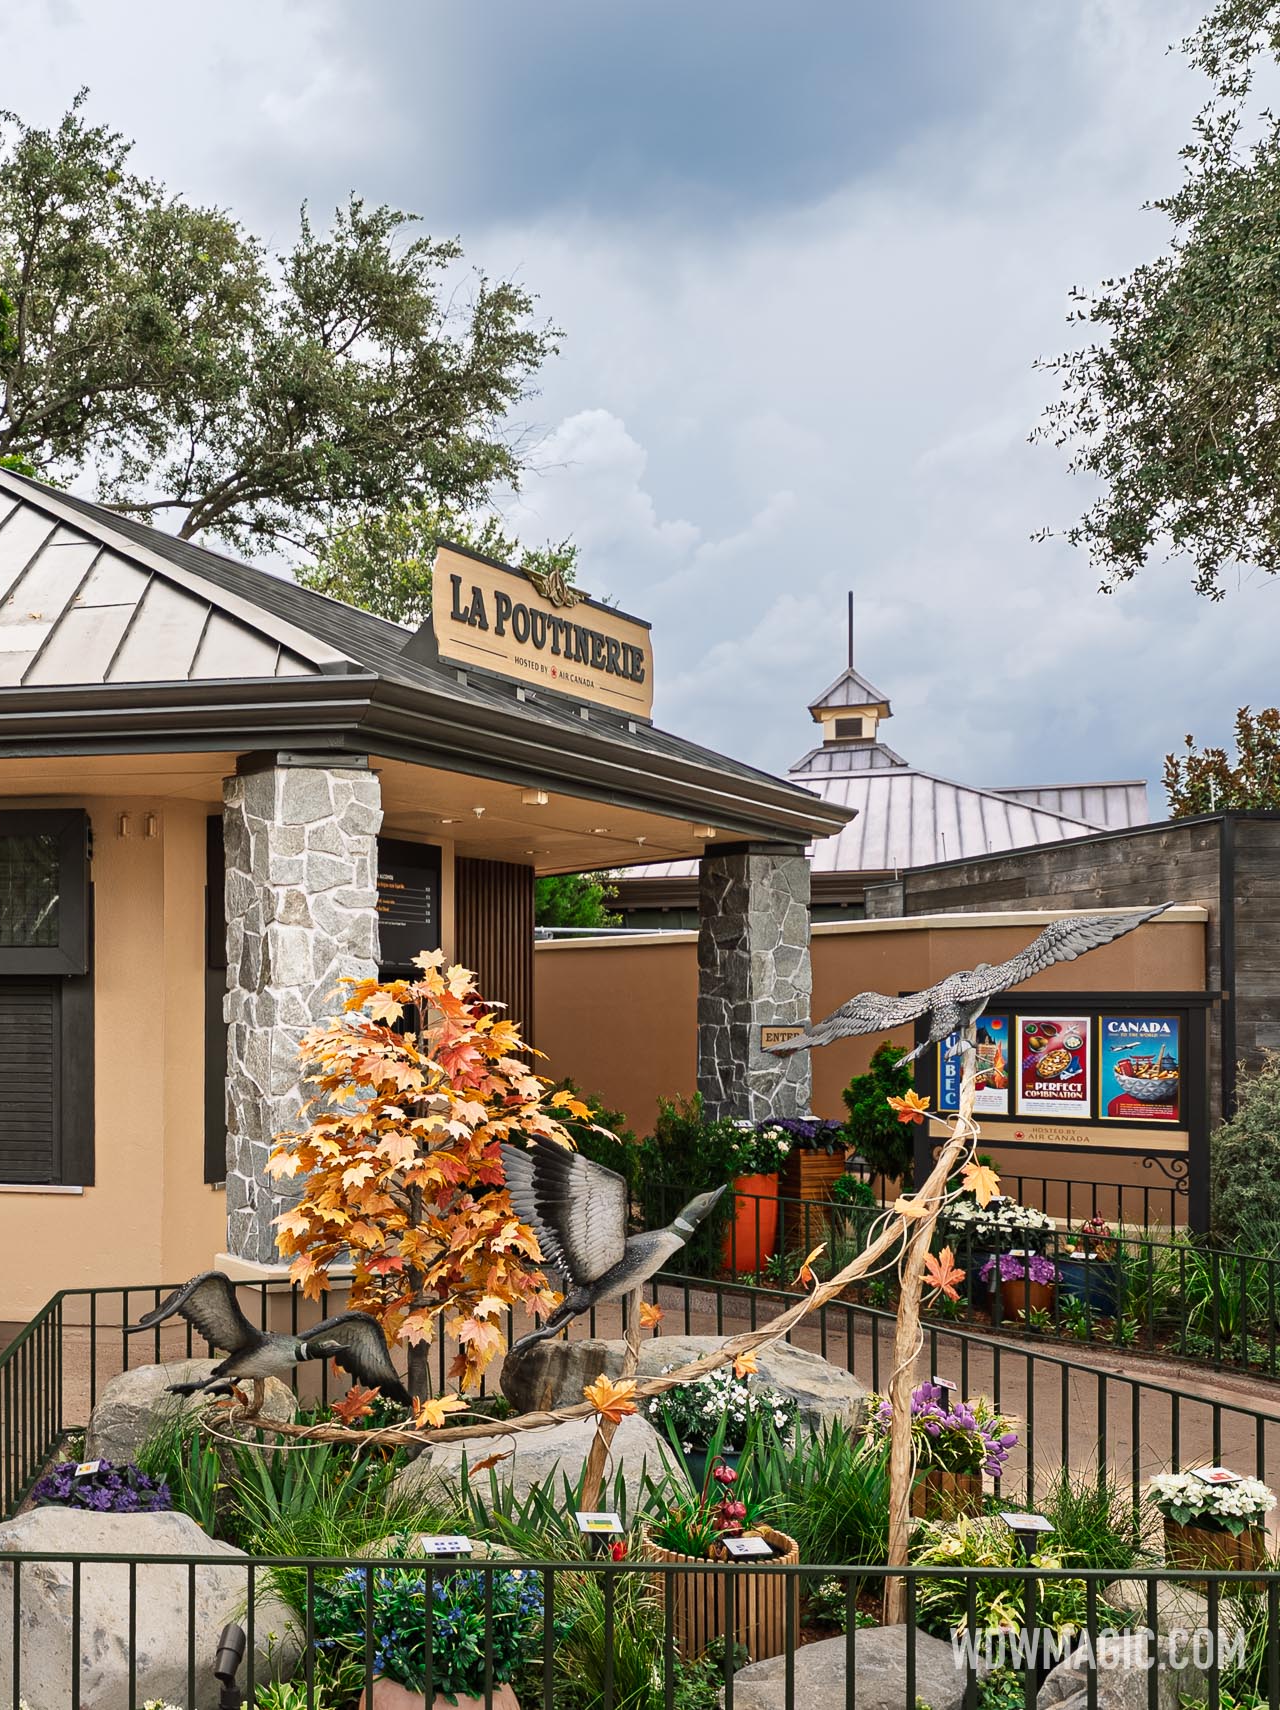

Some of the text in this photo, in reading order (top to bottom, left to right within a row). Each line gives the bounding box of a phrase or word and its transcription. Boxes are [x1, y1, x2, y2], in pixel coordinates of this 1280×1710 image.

[450, 574, 645, 684] LA POUTINERIE
[514, 656, 595, 688] HOSTED BY AIR CANADA
[1107, 1021, 1171, 1033] CANADA
[1035, 1082, 1083, 1092] PERFECT
[1024, 1090, 1083, 1099] COMBINATION
[1032, 1127, 1064, 1135] HOSTED
[1047, 1134, 1090, 1142] CANADA
